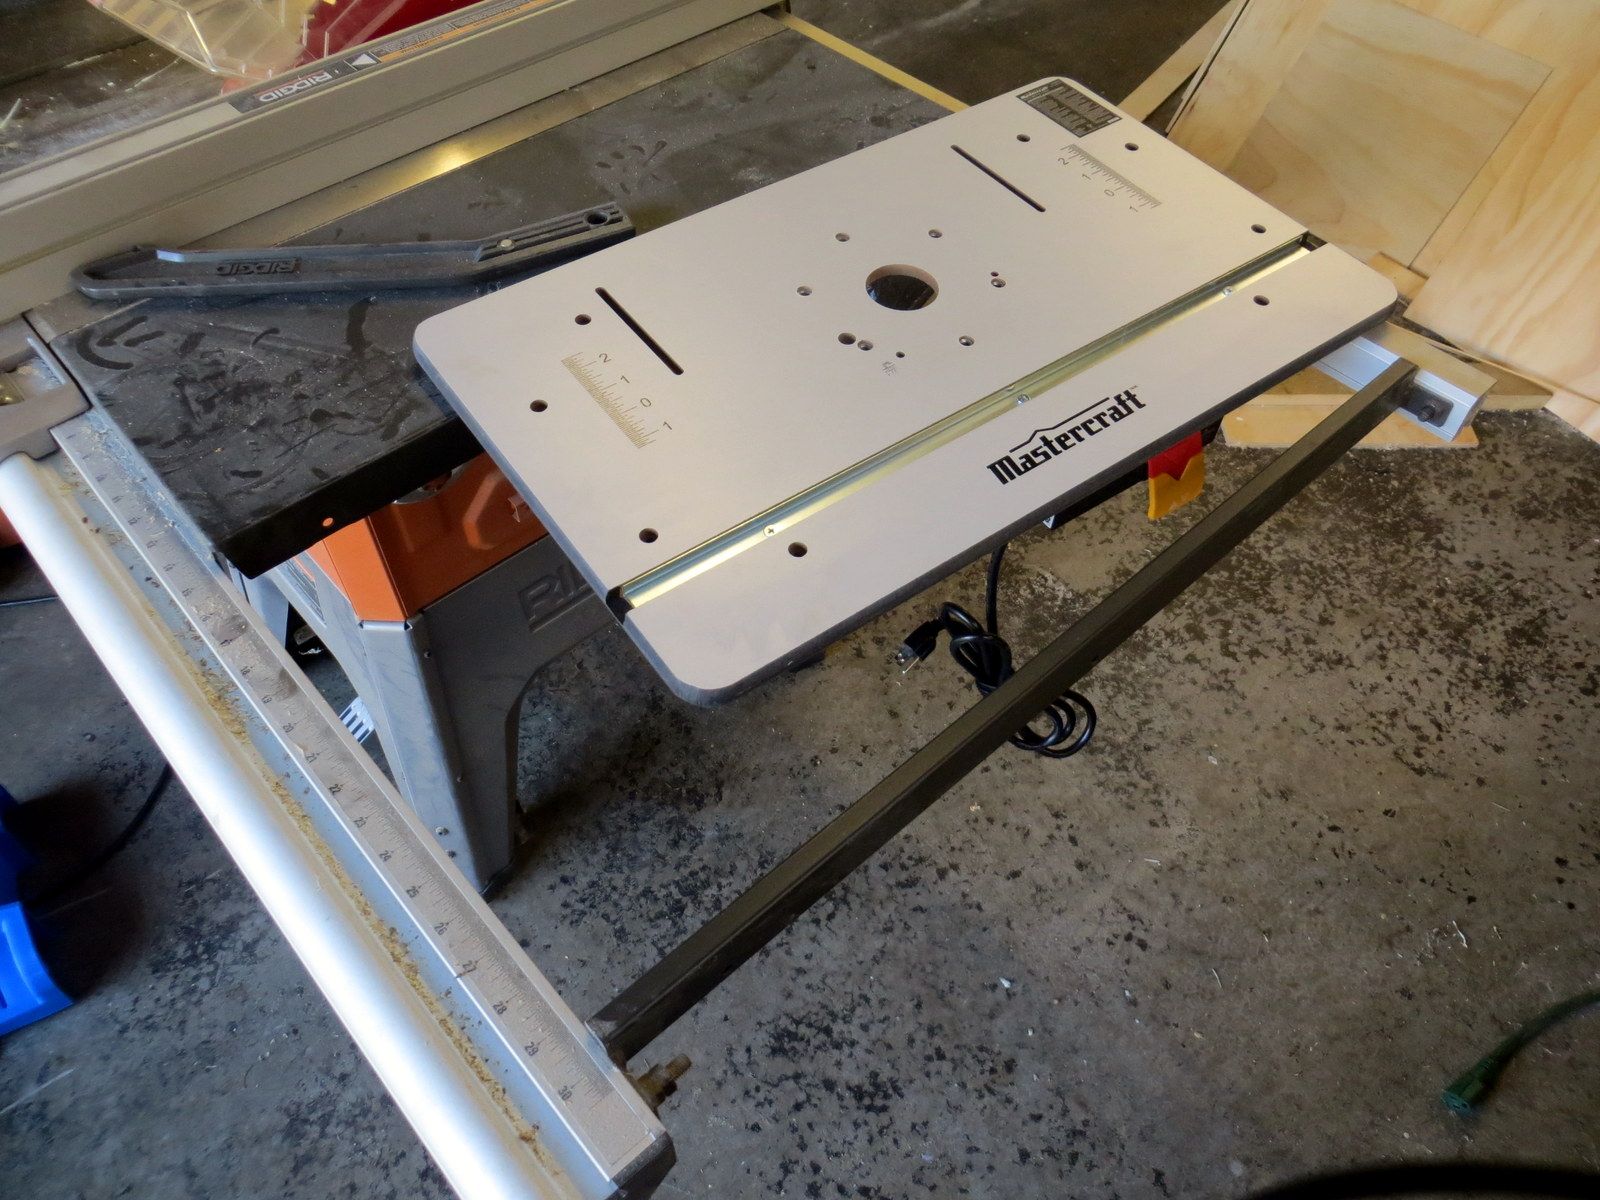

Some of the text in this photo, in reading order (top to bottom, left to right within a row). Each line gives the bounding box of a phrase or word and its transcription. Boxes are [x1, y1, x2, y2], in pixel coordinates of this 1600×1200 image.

[258, 72, 334, 103] RIDGID
[1057, 157, 1070, 166] 2
[1103, 189, 1115, 197] 0
[216, 257, 302, 277] RIDGID
[598, 353, 673, 430] 2 1 0 1
[986, 389, 1147, 485] Mastercraft
[283, 723, 294, 733] 20
[305, 753, 317, 763] 21
[329, 784, 342, 795] 22
[354, 817, 366, 828] 23
[379, 850, 391, 862] 24
[406, 886, 419, 898] 25
[434, 922, 448, 935] 26
[462, 960, 477, 973] 27
[493, 1002, 507, 1015] 28
[525, 1042, 539, 1056] 29
[558, 1086, 572, 1100] 30
